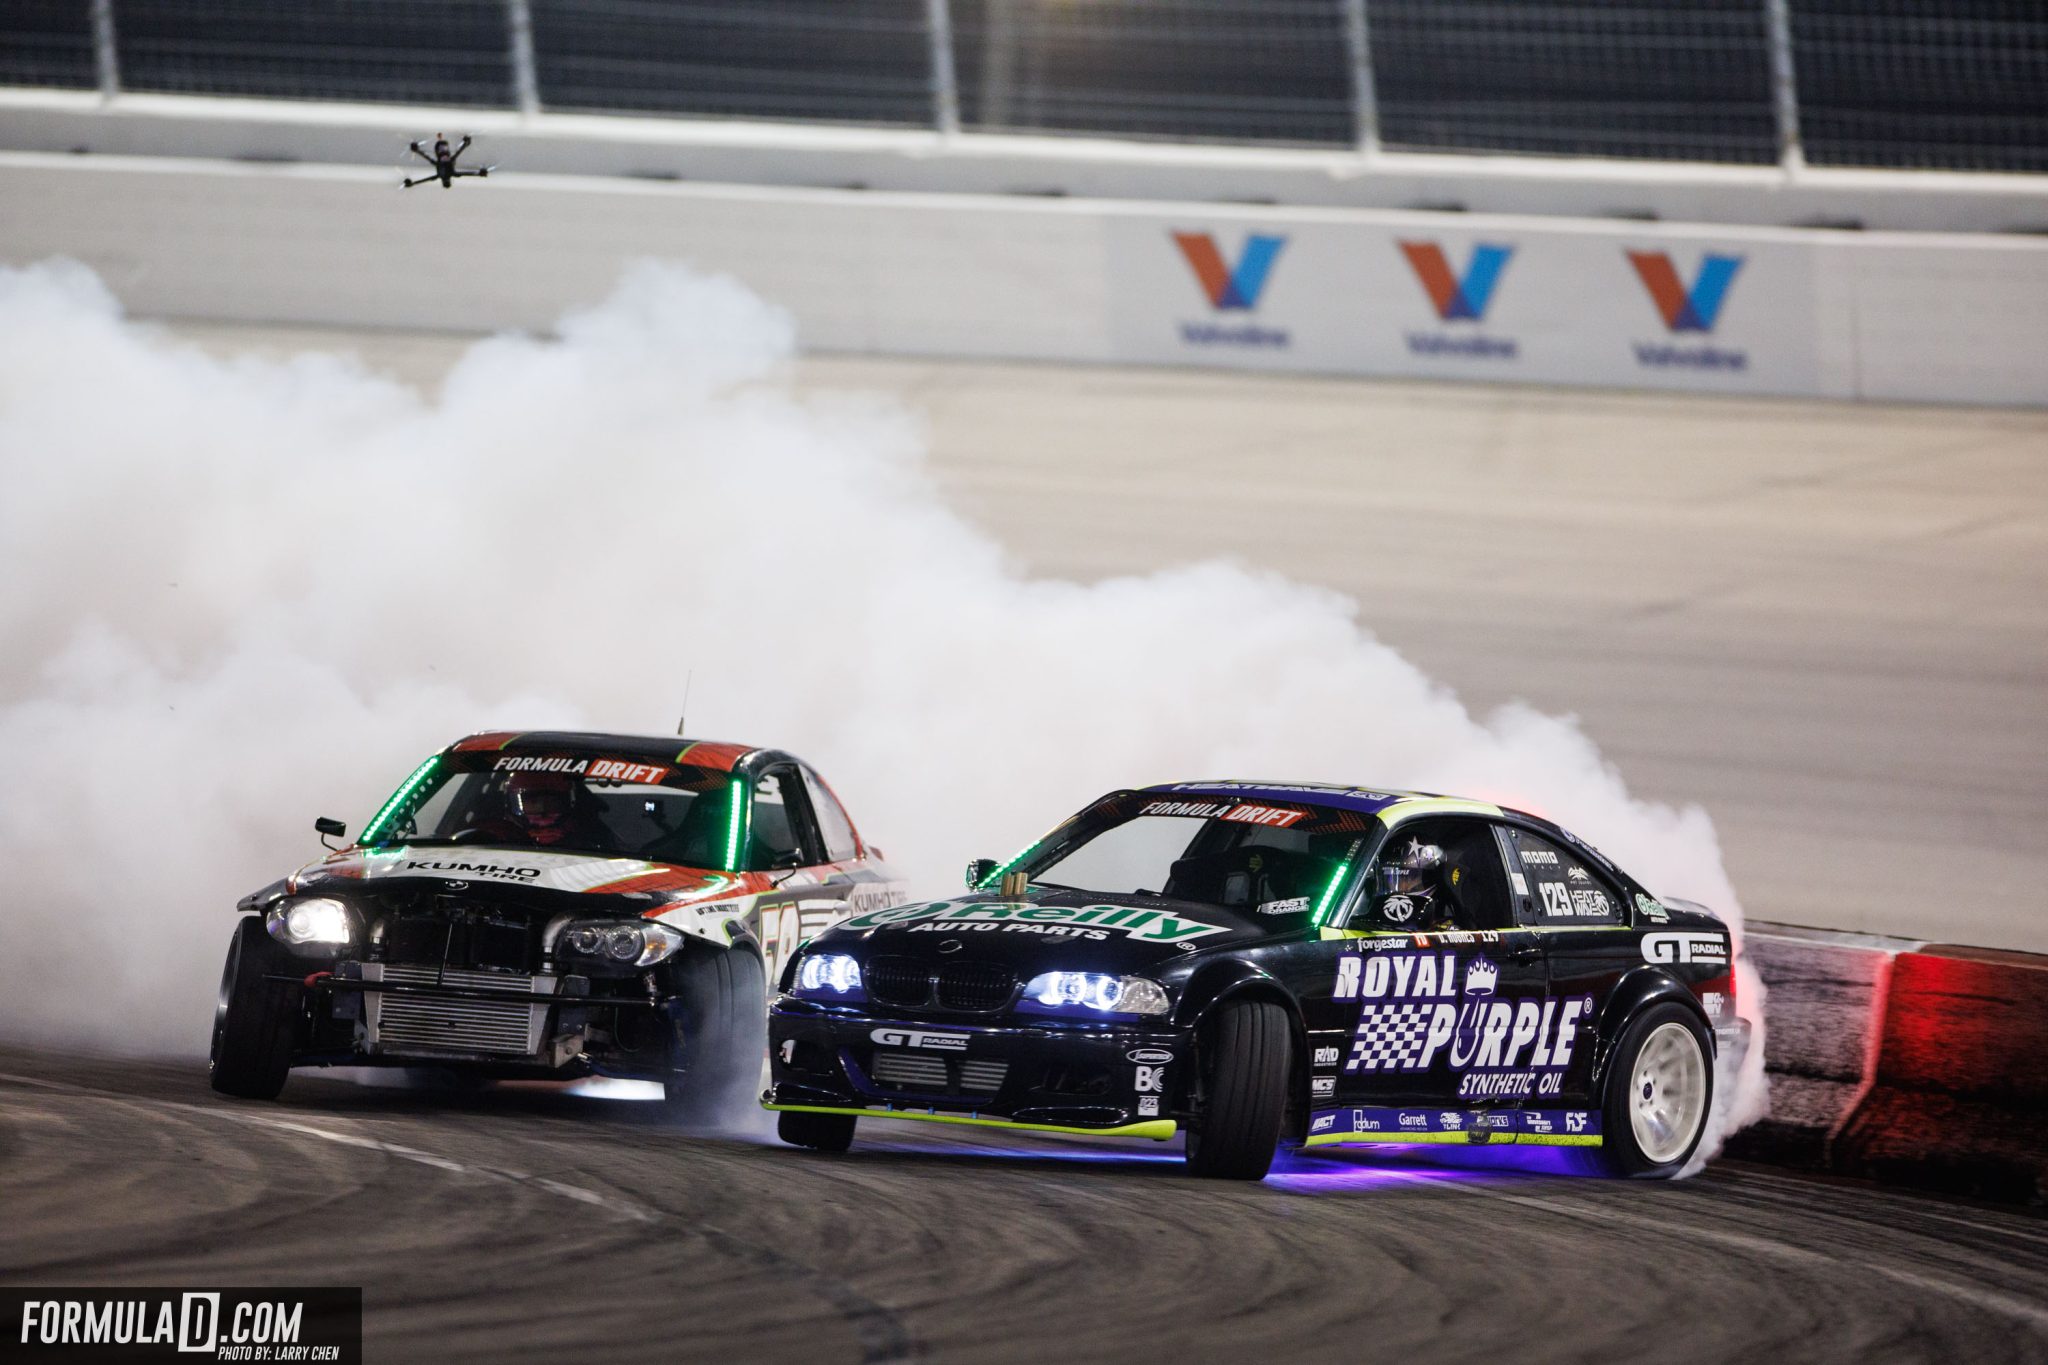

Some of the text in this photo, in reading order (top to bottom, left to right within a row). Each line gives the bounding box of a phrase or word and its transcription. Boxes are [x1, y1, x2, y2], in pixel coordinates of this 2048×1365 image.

[493, 757, 664, 783] FORMULA DRIFT
[1139, 802, 1304, 827] FORMULA DRIFT
[407, 861, 541, 877] KUMHO
[476, 872, 536, 884] TIRE
[855, 892, 891, 912] KUMHO
[1267, 897, 1310, 909] FAST
[1538, 882, 1574, 917] 129
[1569, 890, 1595, 904] HEAT
[908, 922, 1110, 941] AUTO PARTS
[1357, 937, 1408, 951] forgestar
[1692, 943, 1726, 955] RADIAL
[1333, 955, 1457, 998] ROYAL
[1416, 998, 1583, 1068] PURPLE
[922, 1037, 969, 1047] RADIAL
[1314, 1046, 1339, 1063] RAD
[1459, 1073, 1563, 1095] SYNTHETIC OIL
[1398, 1112, 1428, 1126] Garrett
